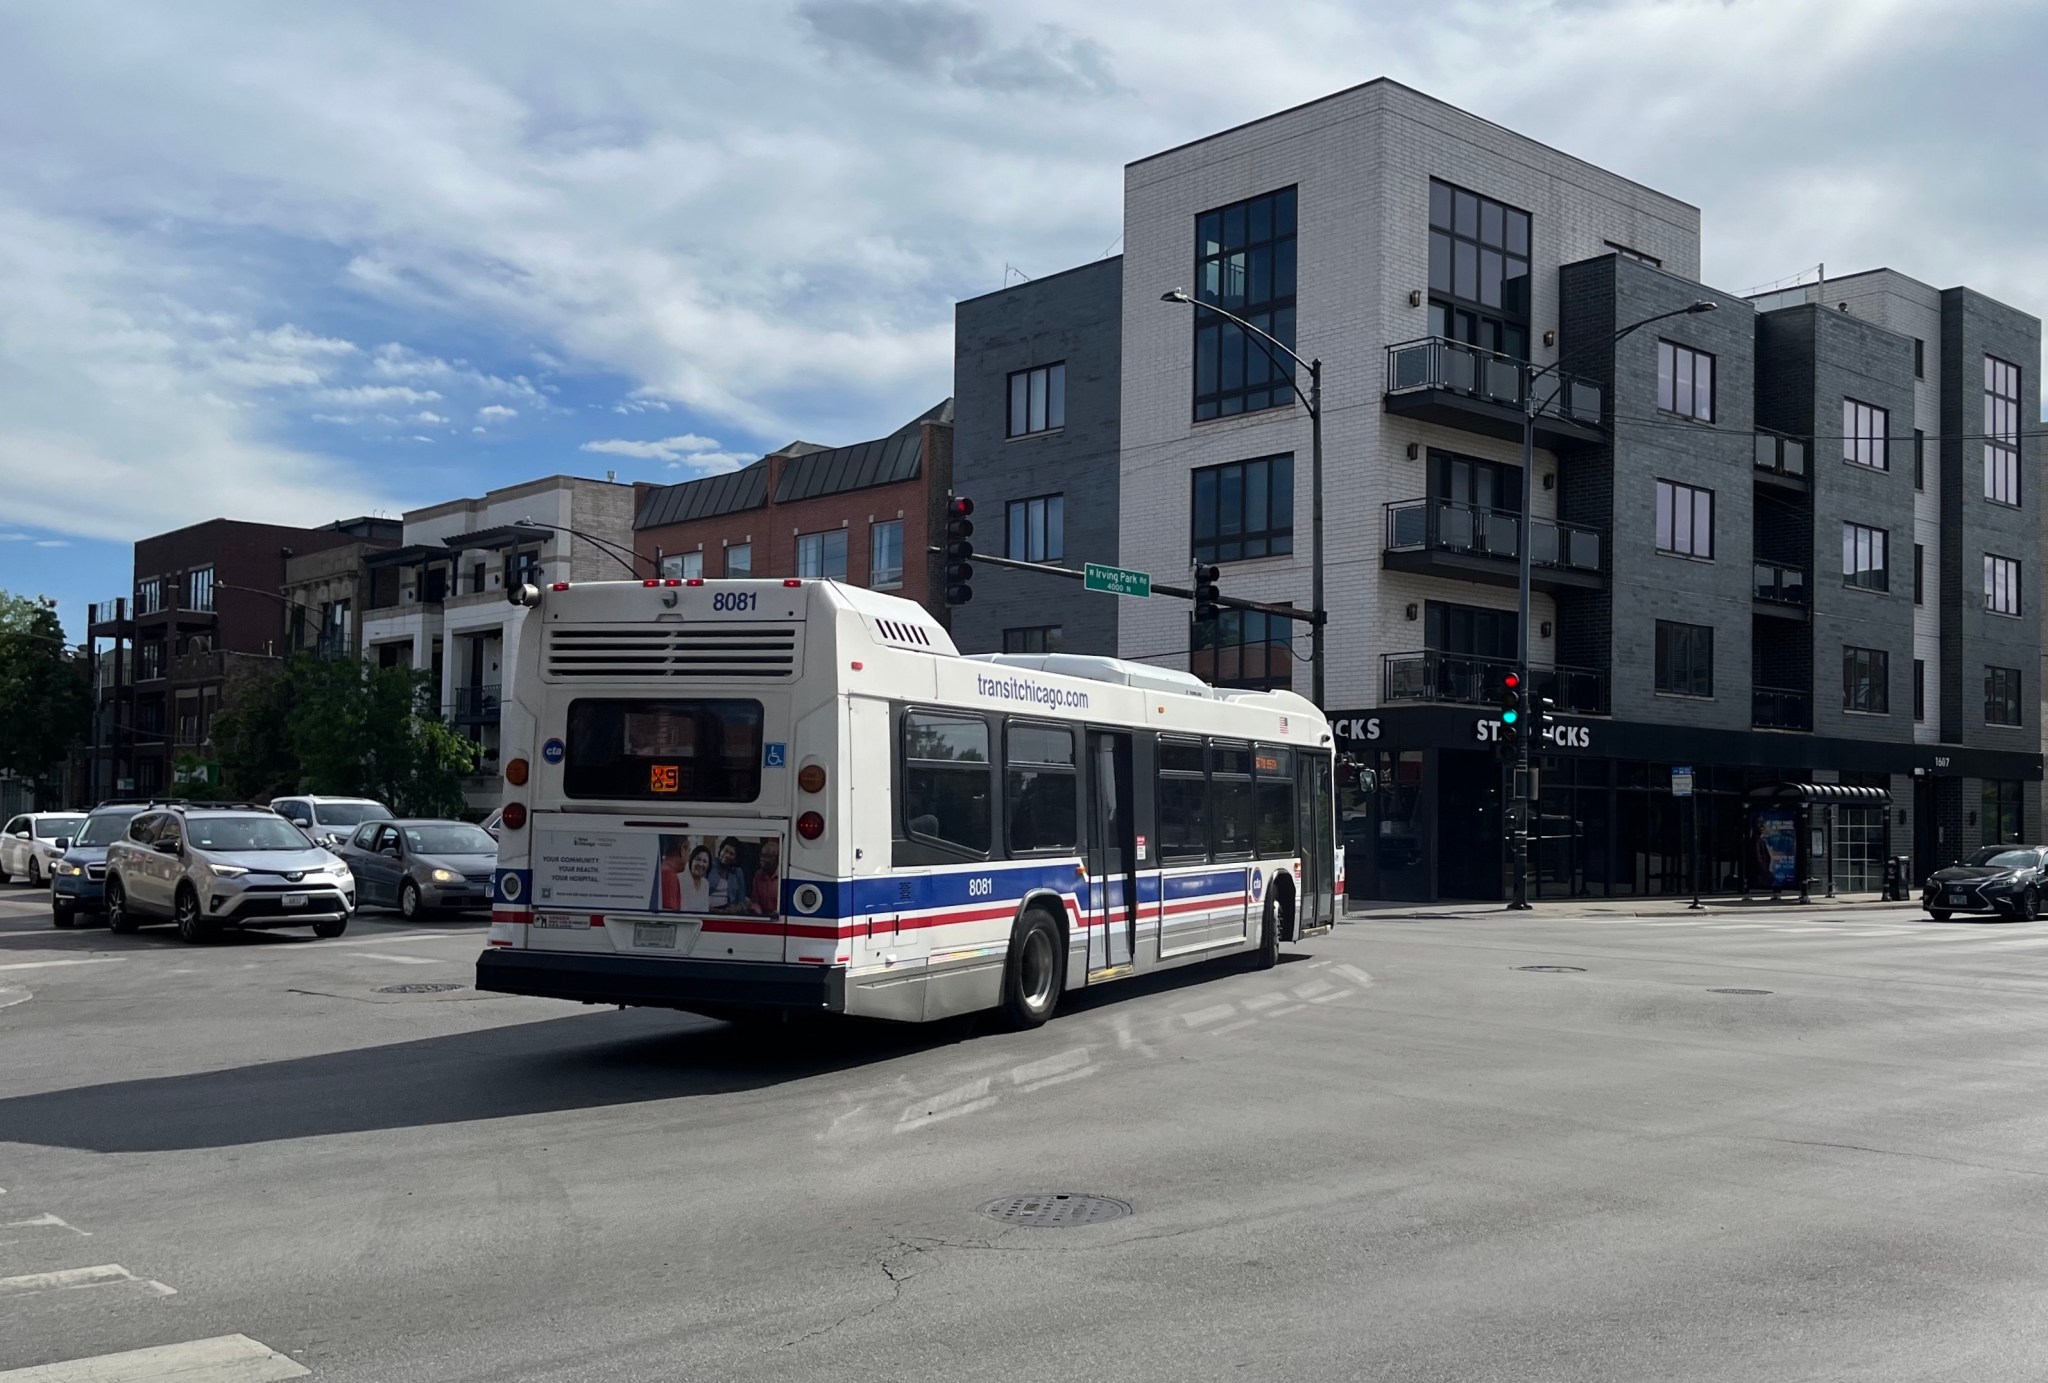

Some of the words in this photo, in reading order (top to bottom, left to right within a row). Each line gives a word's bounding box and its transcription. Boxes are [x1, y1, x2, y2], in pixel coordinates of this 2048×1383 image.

[1095, 568, 1119, 584] Irving
[1120, 572, 1138, 584] Park
[1139, 576, 1147, 585] Rd
[1107, 583, 1124, 592] 4000
[713, 592, 757, 611] 8081
[977, 673, 1089, 710] transitchicago.com
[546, 746, 562, 755] cta
[1935, 756, 1950, 767] 1607
[652, 767, 677, 789] X9
[969, 877, 992, 896] 8081
